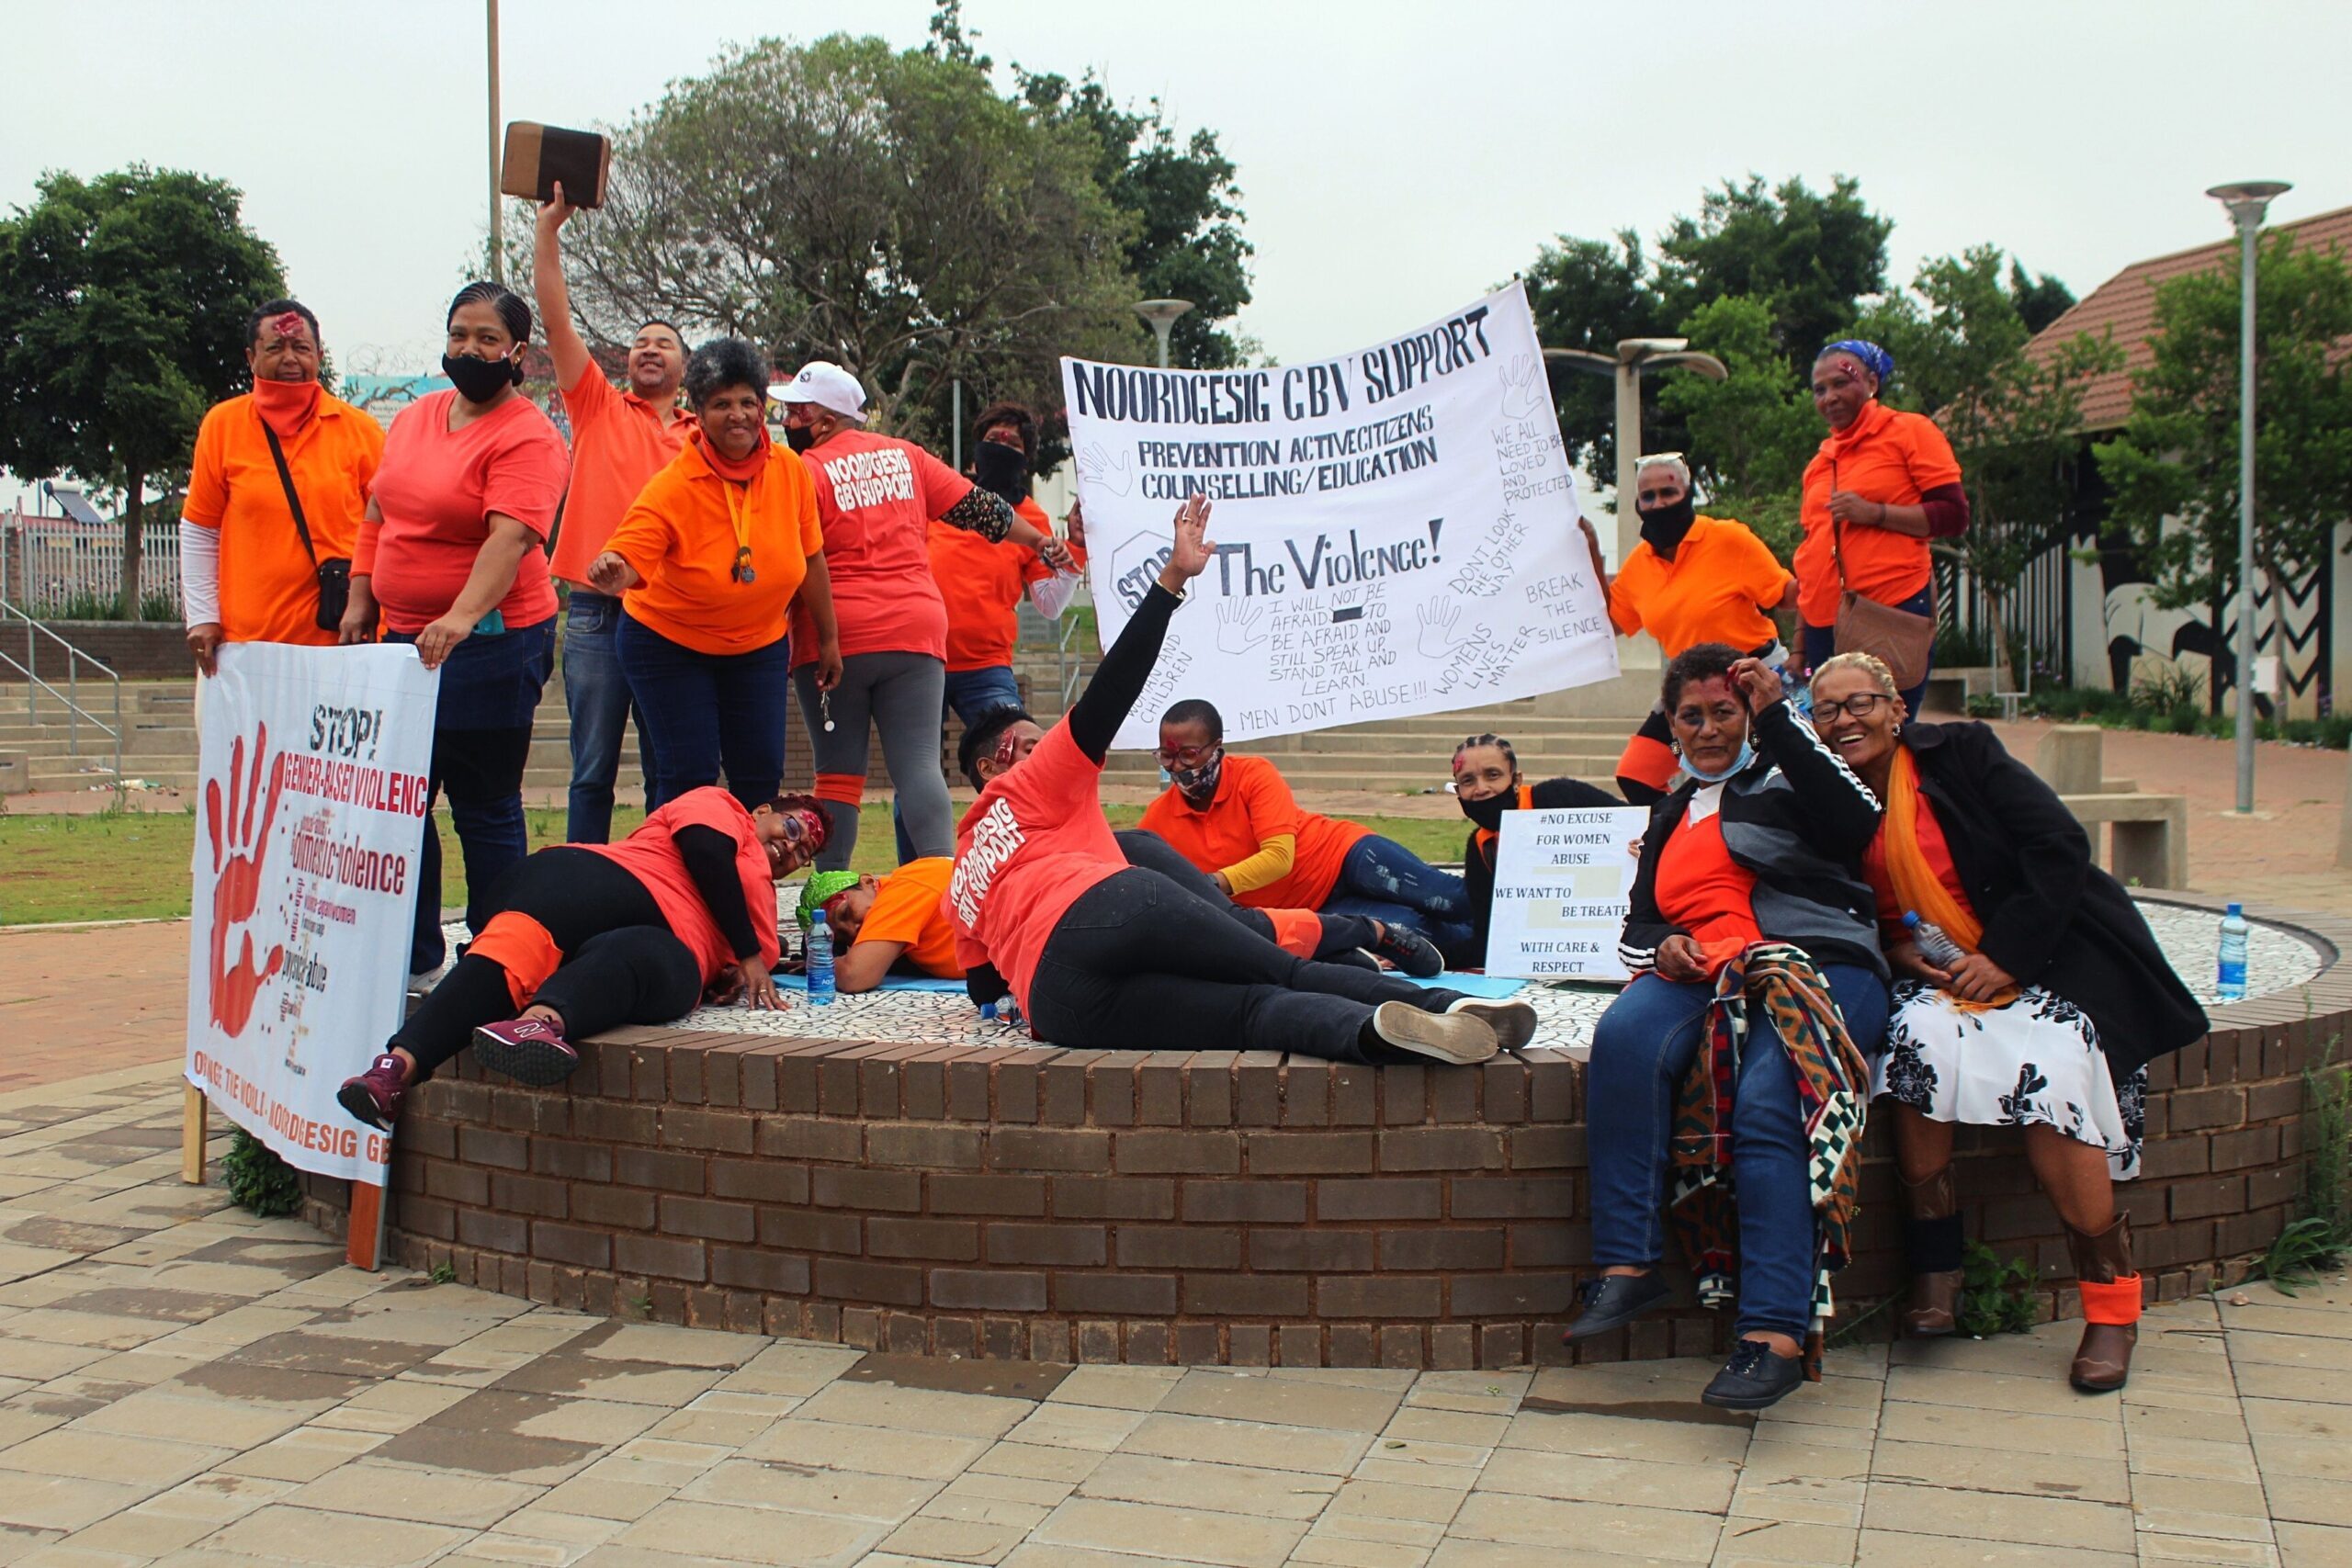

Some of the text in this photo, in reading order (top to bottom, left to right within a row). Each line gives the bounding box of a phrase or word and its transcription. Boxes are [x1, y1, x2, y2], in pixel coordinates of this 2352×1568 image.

[1072, 305, 1491, 424] NOORDGESIG GBV SUPPORT
[1491, 421, 1543, 446] WE ALL
[1496, 434, 1564, 461] NEED TO BE
[1138, 439, 1281, 468] PREVENTION
[1498, 454, 1547, 476] LOVED
[1502, 474, 1527, 490] AND
[1503, 473, 1574, 507] PROTECTED
[1447, 508, 1517, 594] DONT LOOK
[1466, 521, 1529, 597] THE OTHER
[1211, 542, 1285, 596] The
[1269, 581, 1386, 614] I WILL NOT BE
[1525, 572, 1584, 604] BREAK
[1271, 603, 1386, 632] AFRAID TO
[1543, 599, 1577, 618] THE
[1272, 619, 1391, 651] BE AFRAID AND
[1538, 615, 1602, 644] SILENCE
[1158, 634, 1181, 665] AND
[1270, 651, 1306, 667] STILL
[1314, 641, 1361, 663] SPEAK
[1433, 622, 1493, 695] WOMENS
[1464, 640, 1506, 690] LIVES
[1488, 626, 1538, 686] MATTER
[1268, 650, 1396, 682] STAND TALL AND
[1140, 651, 1193, 724] CHILDREN
[1239, 708, 1279, 732] MEN
[1288, 697, 1338, 725] DONT
[310, 704, 383, 761] STOP!
[353, 766, 428, 819] VIOLENC
[1540, 812, 1613, 825] #NO EXCUSE
[1536, 833, 1611, 846] FOR WOMEN
[1551, 853, 1591, 865] ABUSE
[1495, 887, 1572, 899] WE WANT TO
[1562, 905, 1629, 918] BE TREATE
[1521, 942, 1600, 953] WITH CARE &
[1532, 961, 1585, 974] RESPECT
